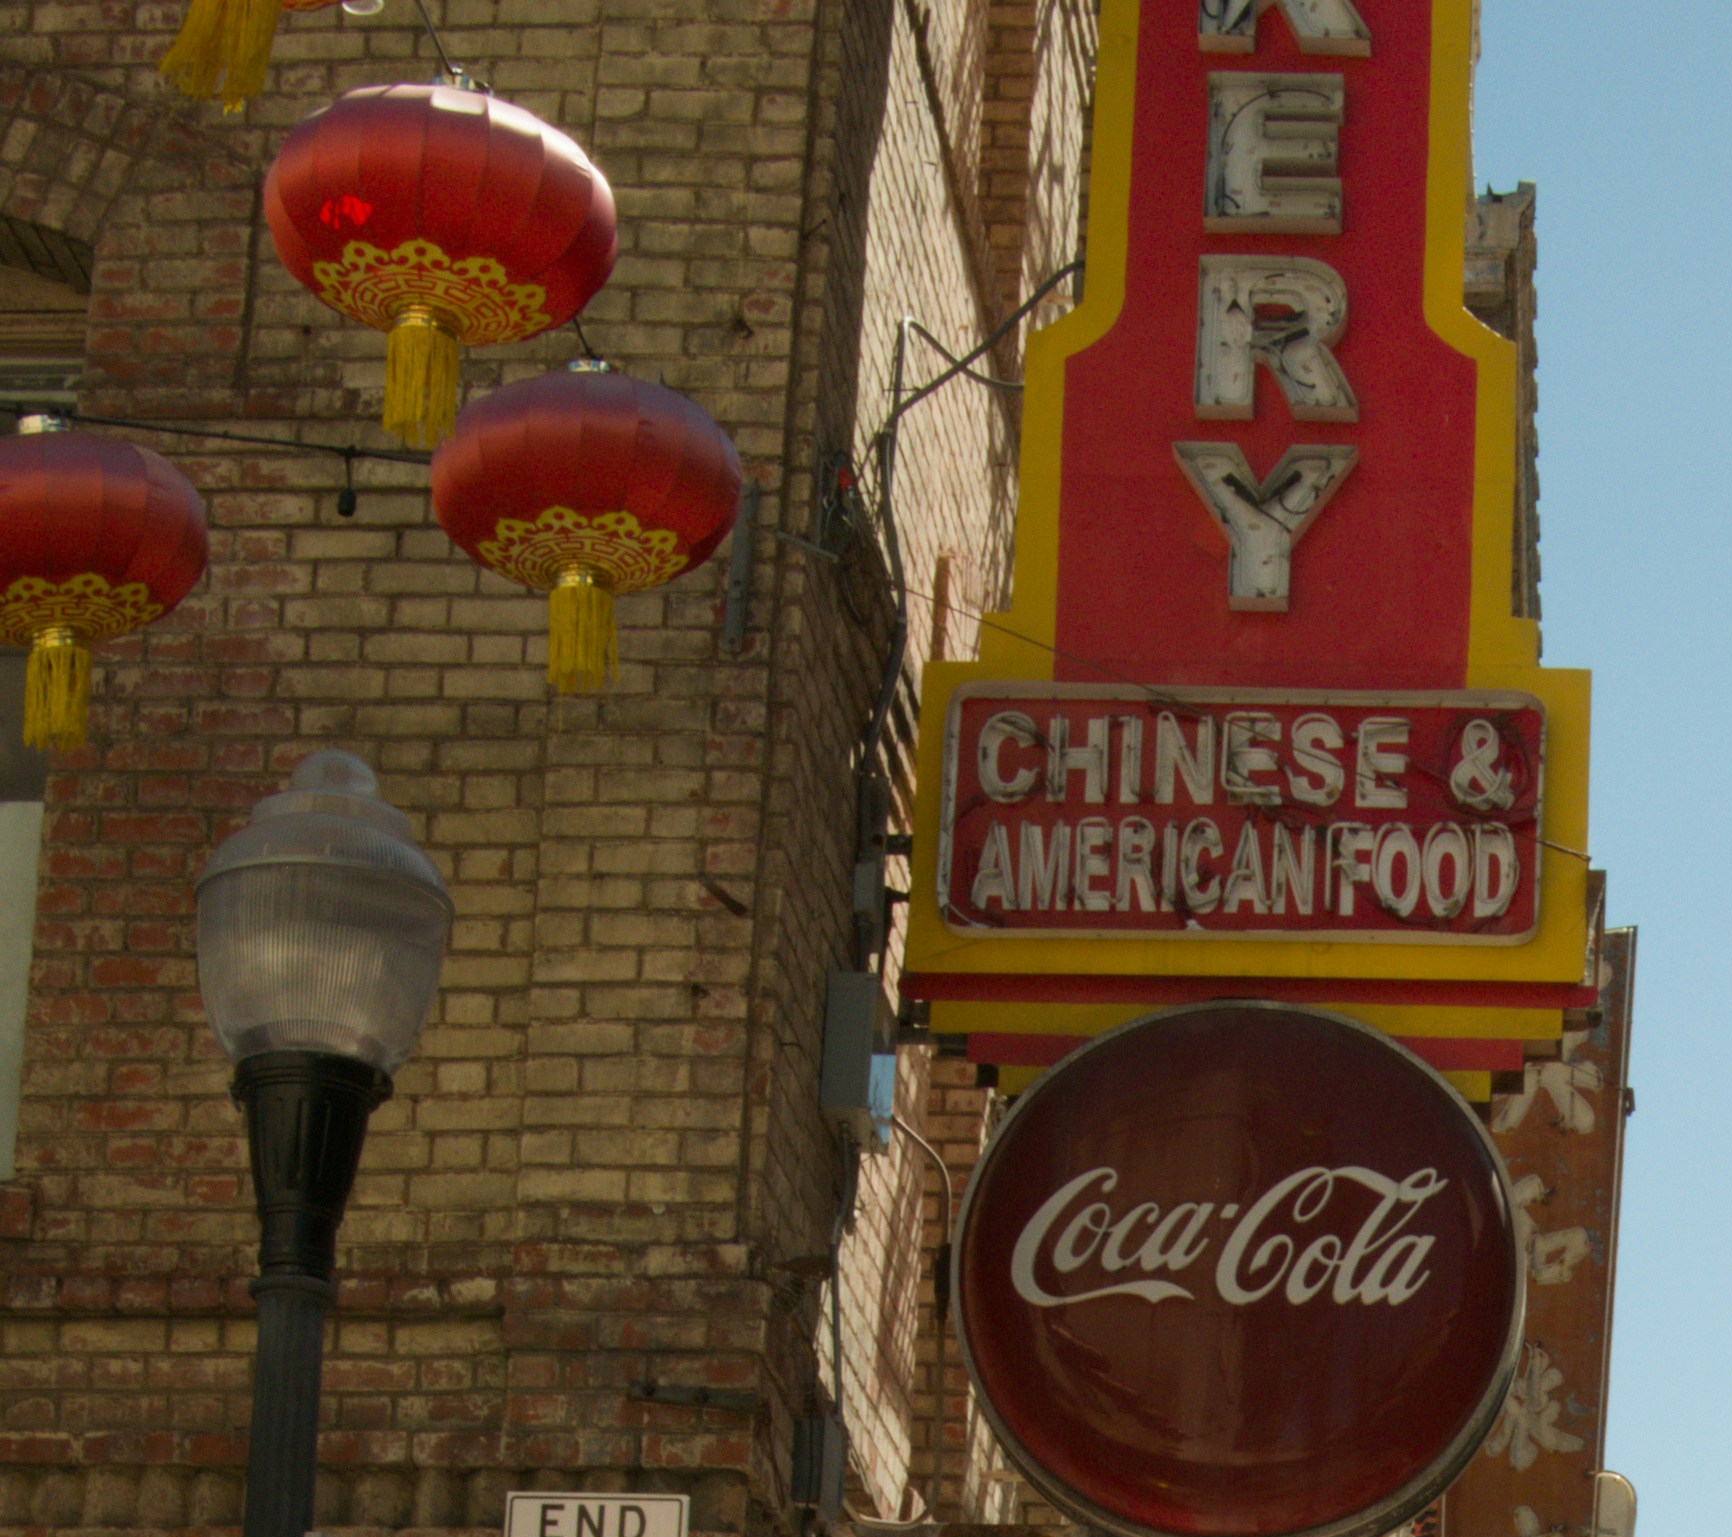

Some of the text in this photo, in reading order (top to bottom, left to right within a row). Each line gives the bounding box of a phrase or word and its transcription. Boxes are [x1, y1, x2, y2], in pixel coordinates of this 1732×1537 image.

[976, 710, 1517, 810] CHINESE &
[972, 815, 1519, 919] AMERICAN FOOD
[1010, 1166, 1449, 1307] Coca-Cola
